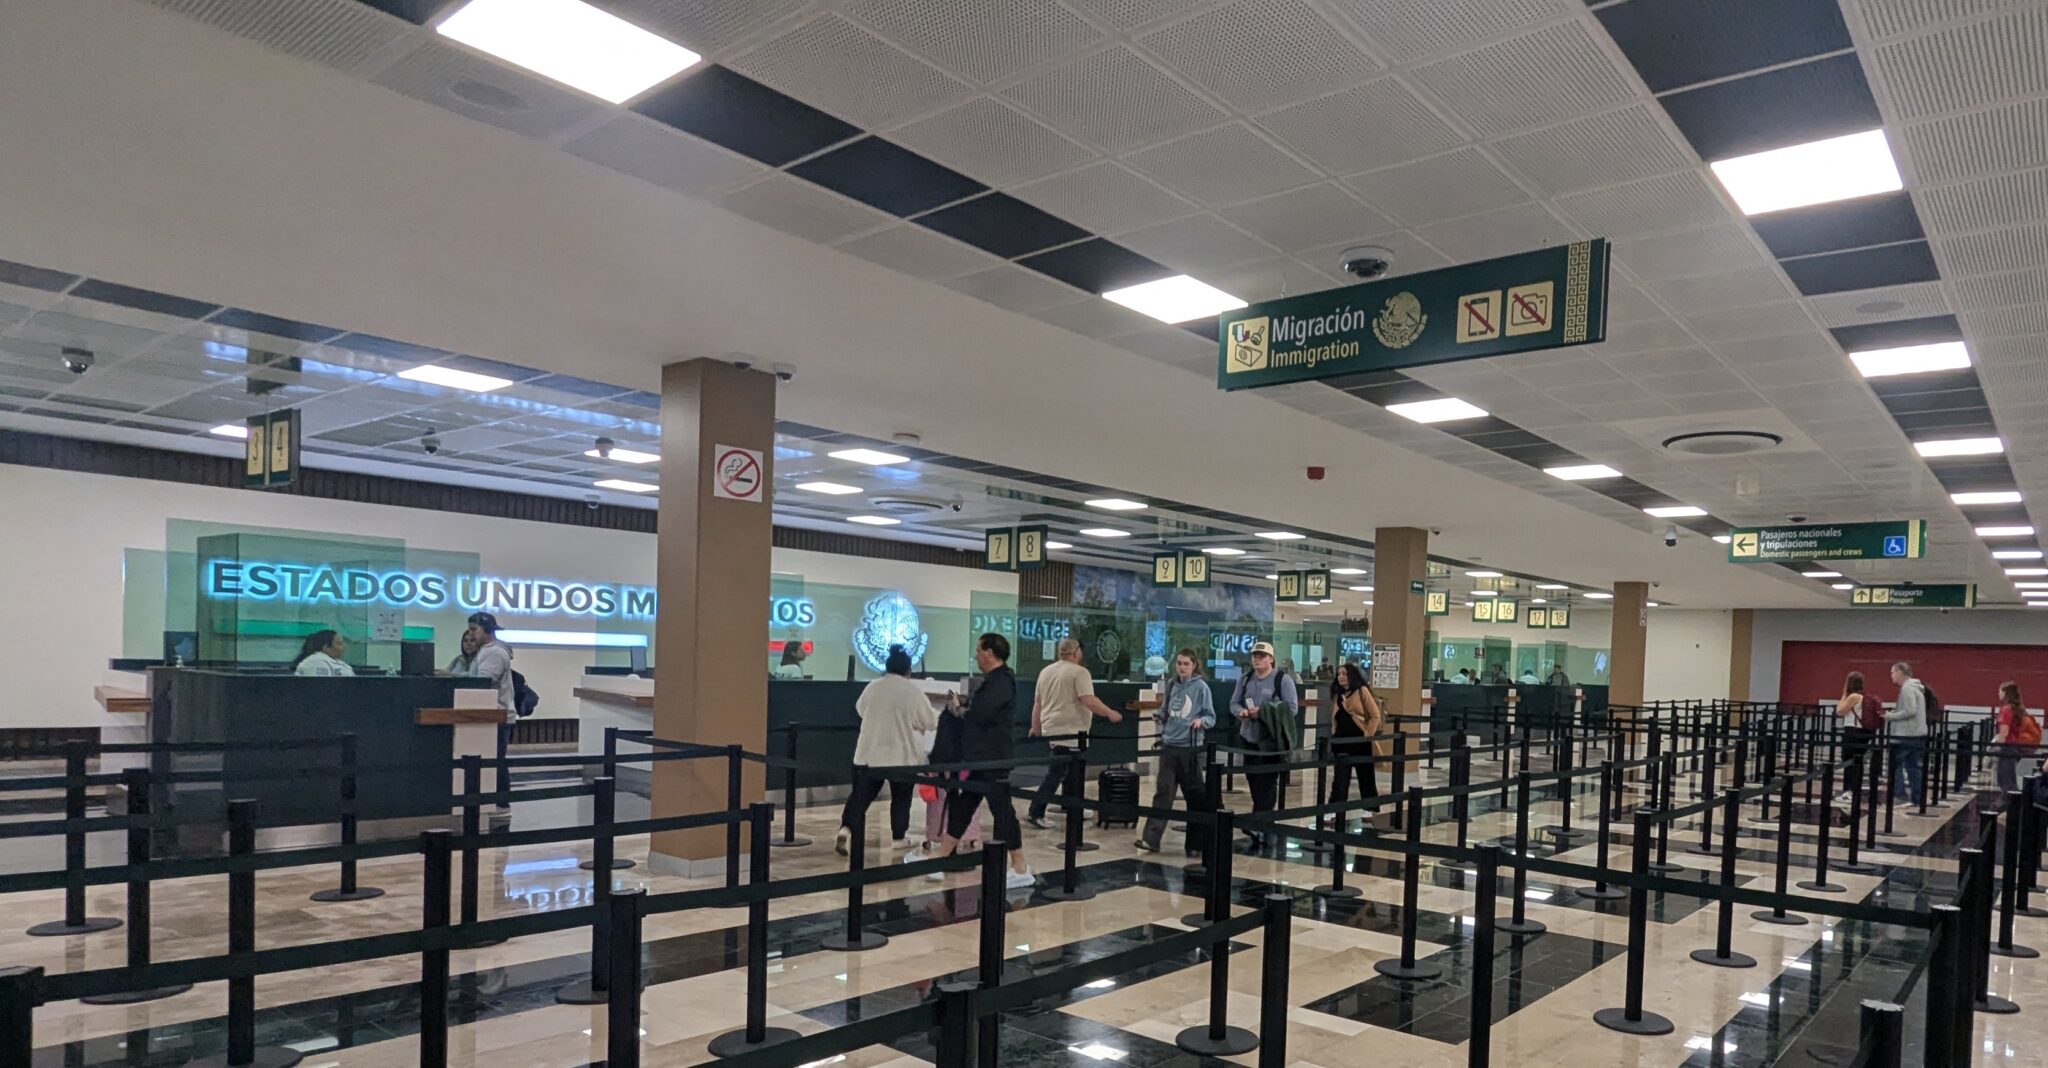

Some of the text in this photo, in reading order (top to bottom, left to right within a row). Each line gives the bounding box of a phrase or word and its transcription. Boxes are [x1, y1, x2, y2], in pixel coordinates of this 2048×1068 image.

[1272, 305, 1365, 346] Migración
[1271, 340, 1359, 369] Immigration
[252, 432, 260, 461] 3
[276, 427, 284, 457] 4
[1761, 528, 1842, 540] Pasajeros nacionales
[994, 537, 1003, 555] 7
[1026, 534, 1034, 554] 8
[1760, 540, 1818, 551] y tripulaciones
[1760, 550, 1789, 558] Domestic
[1791, 549, 1827, 558] passengers
[1162, 559, 1170, 576] 9
[1189, 559, 1203, 575] 10
[211, 562, 447, 606] ESTADOS
[460, 577, 617, 615] UNIDOS
[1283, 576, 1294, 591] 11
[1311, 576, 1323, 591] 12
[1432, 594, 1442, 607] 14
[1479, 603, 1489, 615] 15
[1502, 604, 1513, 616] 16
[1532, 611, 1542, 622] 17
[1555, 611, 1565, 622] 18
